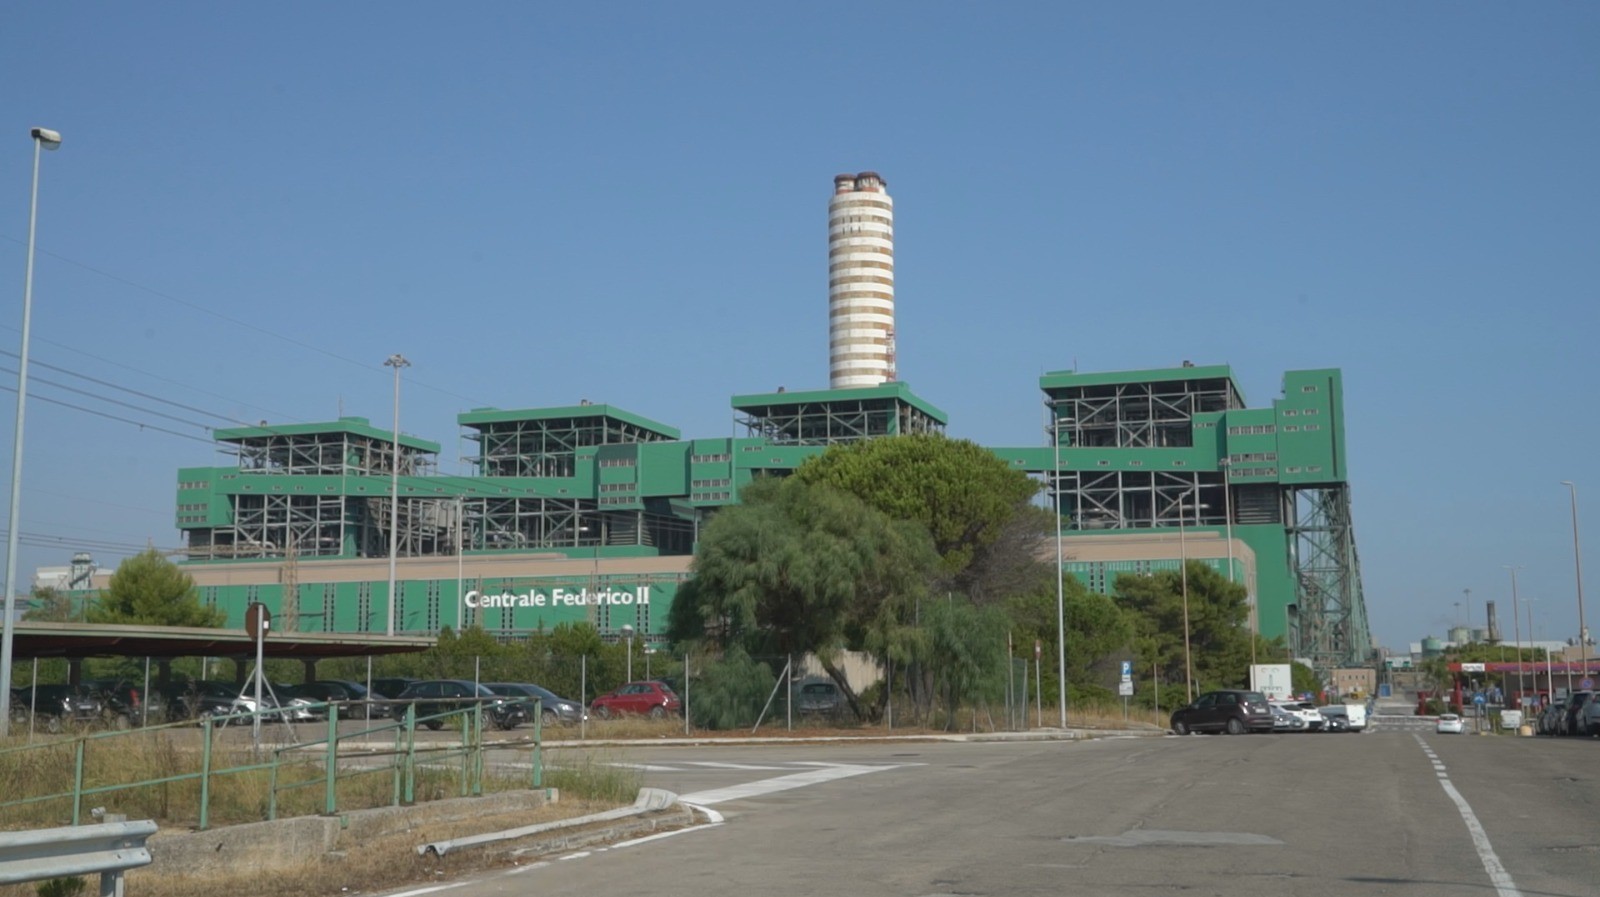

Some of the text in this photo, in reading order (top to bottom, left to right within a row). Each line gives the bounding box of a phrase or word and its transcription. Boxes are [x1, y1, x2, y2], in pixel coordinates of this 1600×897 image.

[464, 586, 649, 608] Centrale Federico II
[1123, 662, 1130, 674] P
